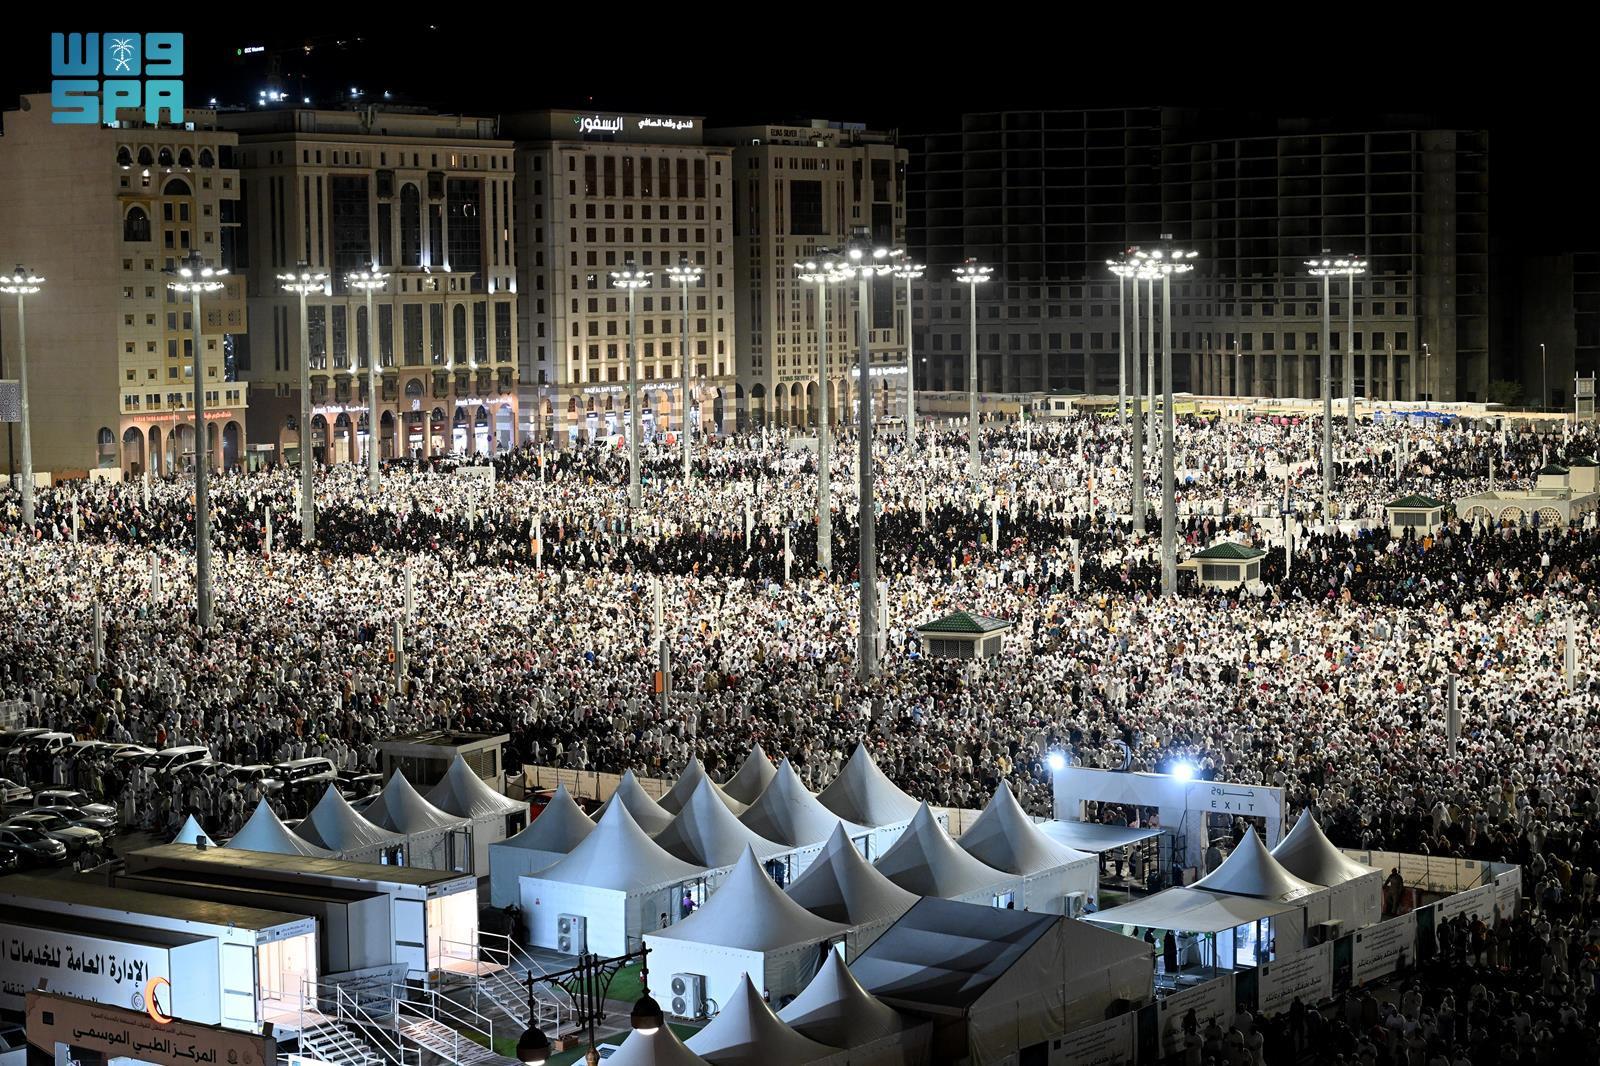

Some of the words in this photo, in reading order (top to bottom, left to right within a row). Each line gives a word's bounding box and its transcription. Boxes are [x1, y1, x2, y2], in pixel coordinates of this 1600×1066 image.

[1211, 786, 1254, 797] خروج
[1211, 800, 1254, 812] EXIT
[10, 939, 61, 969] للخدمات
[65, 946, 105, 975] العامة
[108, 954, 149, 988] الإدارة
[73, 1027, 130, 1045] الموسمي
[133, 1036, 170, 1055] الطبي
[173, 1044, 216, 1064] المركز
